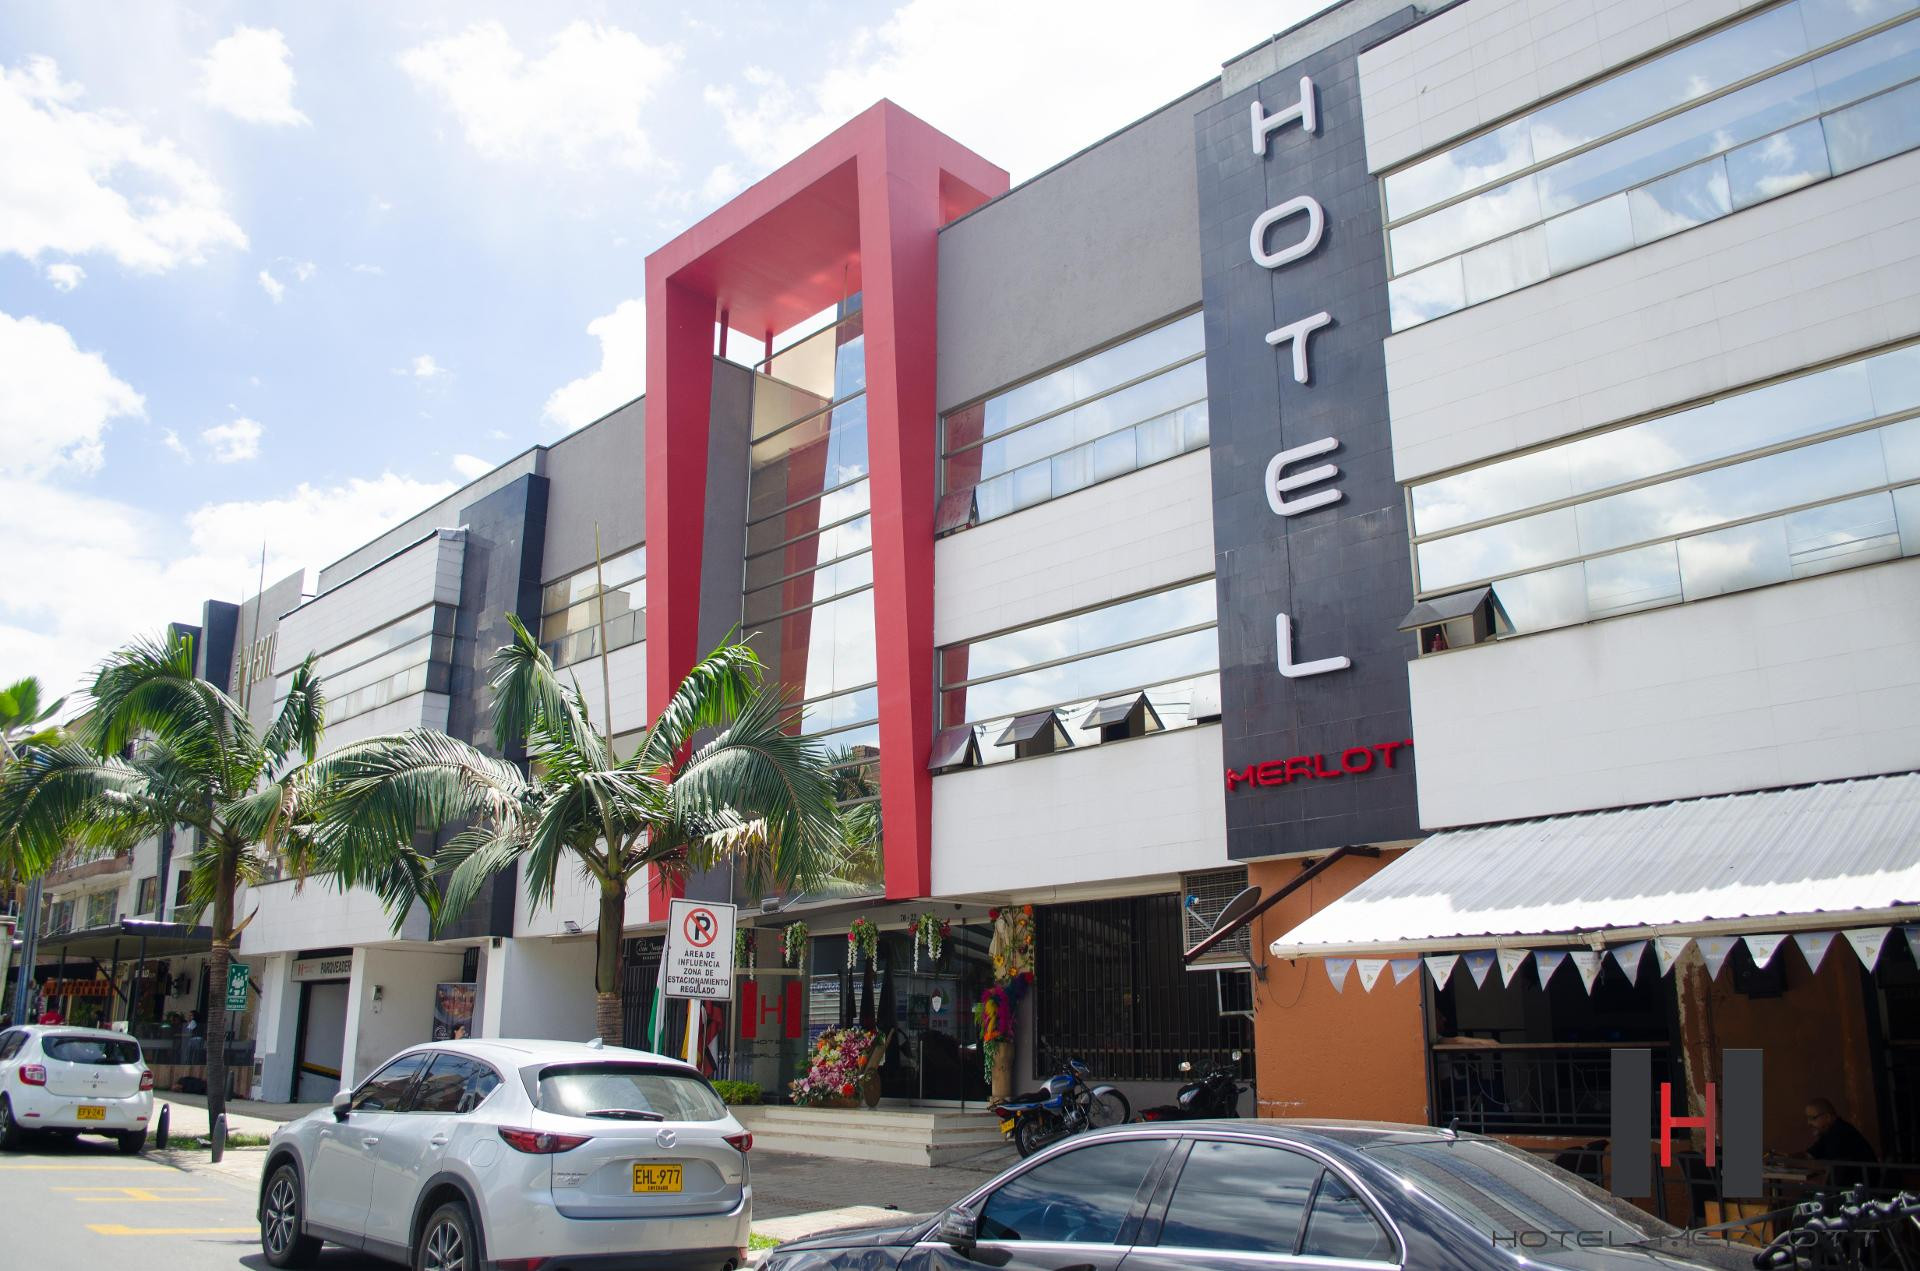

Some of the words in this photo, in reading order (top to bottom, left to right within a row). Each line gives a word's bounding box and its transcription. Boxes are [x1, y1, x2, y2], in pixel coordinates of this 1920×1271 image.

[1250, 75, 1351, 679] HOTEL
[1226, 738, 1414, 792] MERLOT
[705, 951, 715, 959] DE
[678, 958, 720, 968] INFLUENCIA
[683, 967, 701, 976] ZONA
[705, 969, 714, 977] DE
[667, 975, 729, 986] ESTACIONAMIENTO
[680, 985, 716, 994] REGULADO
